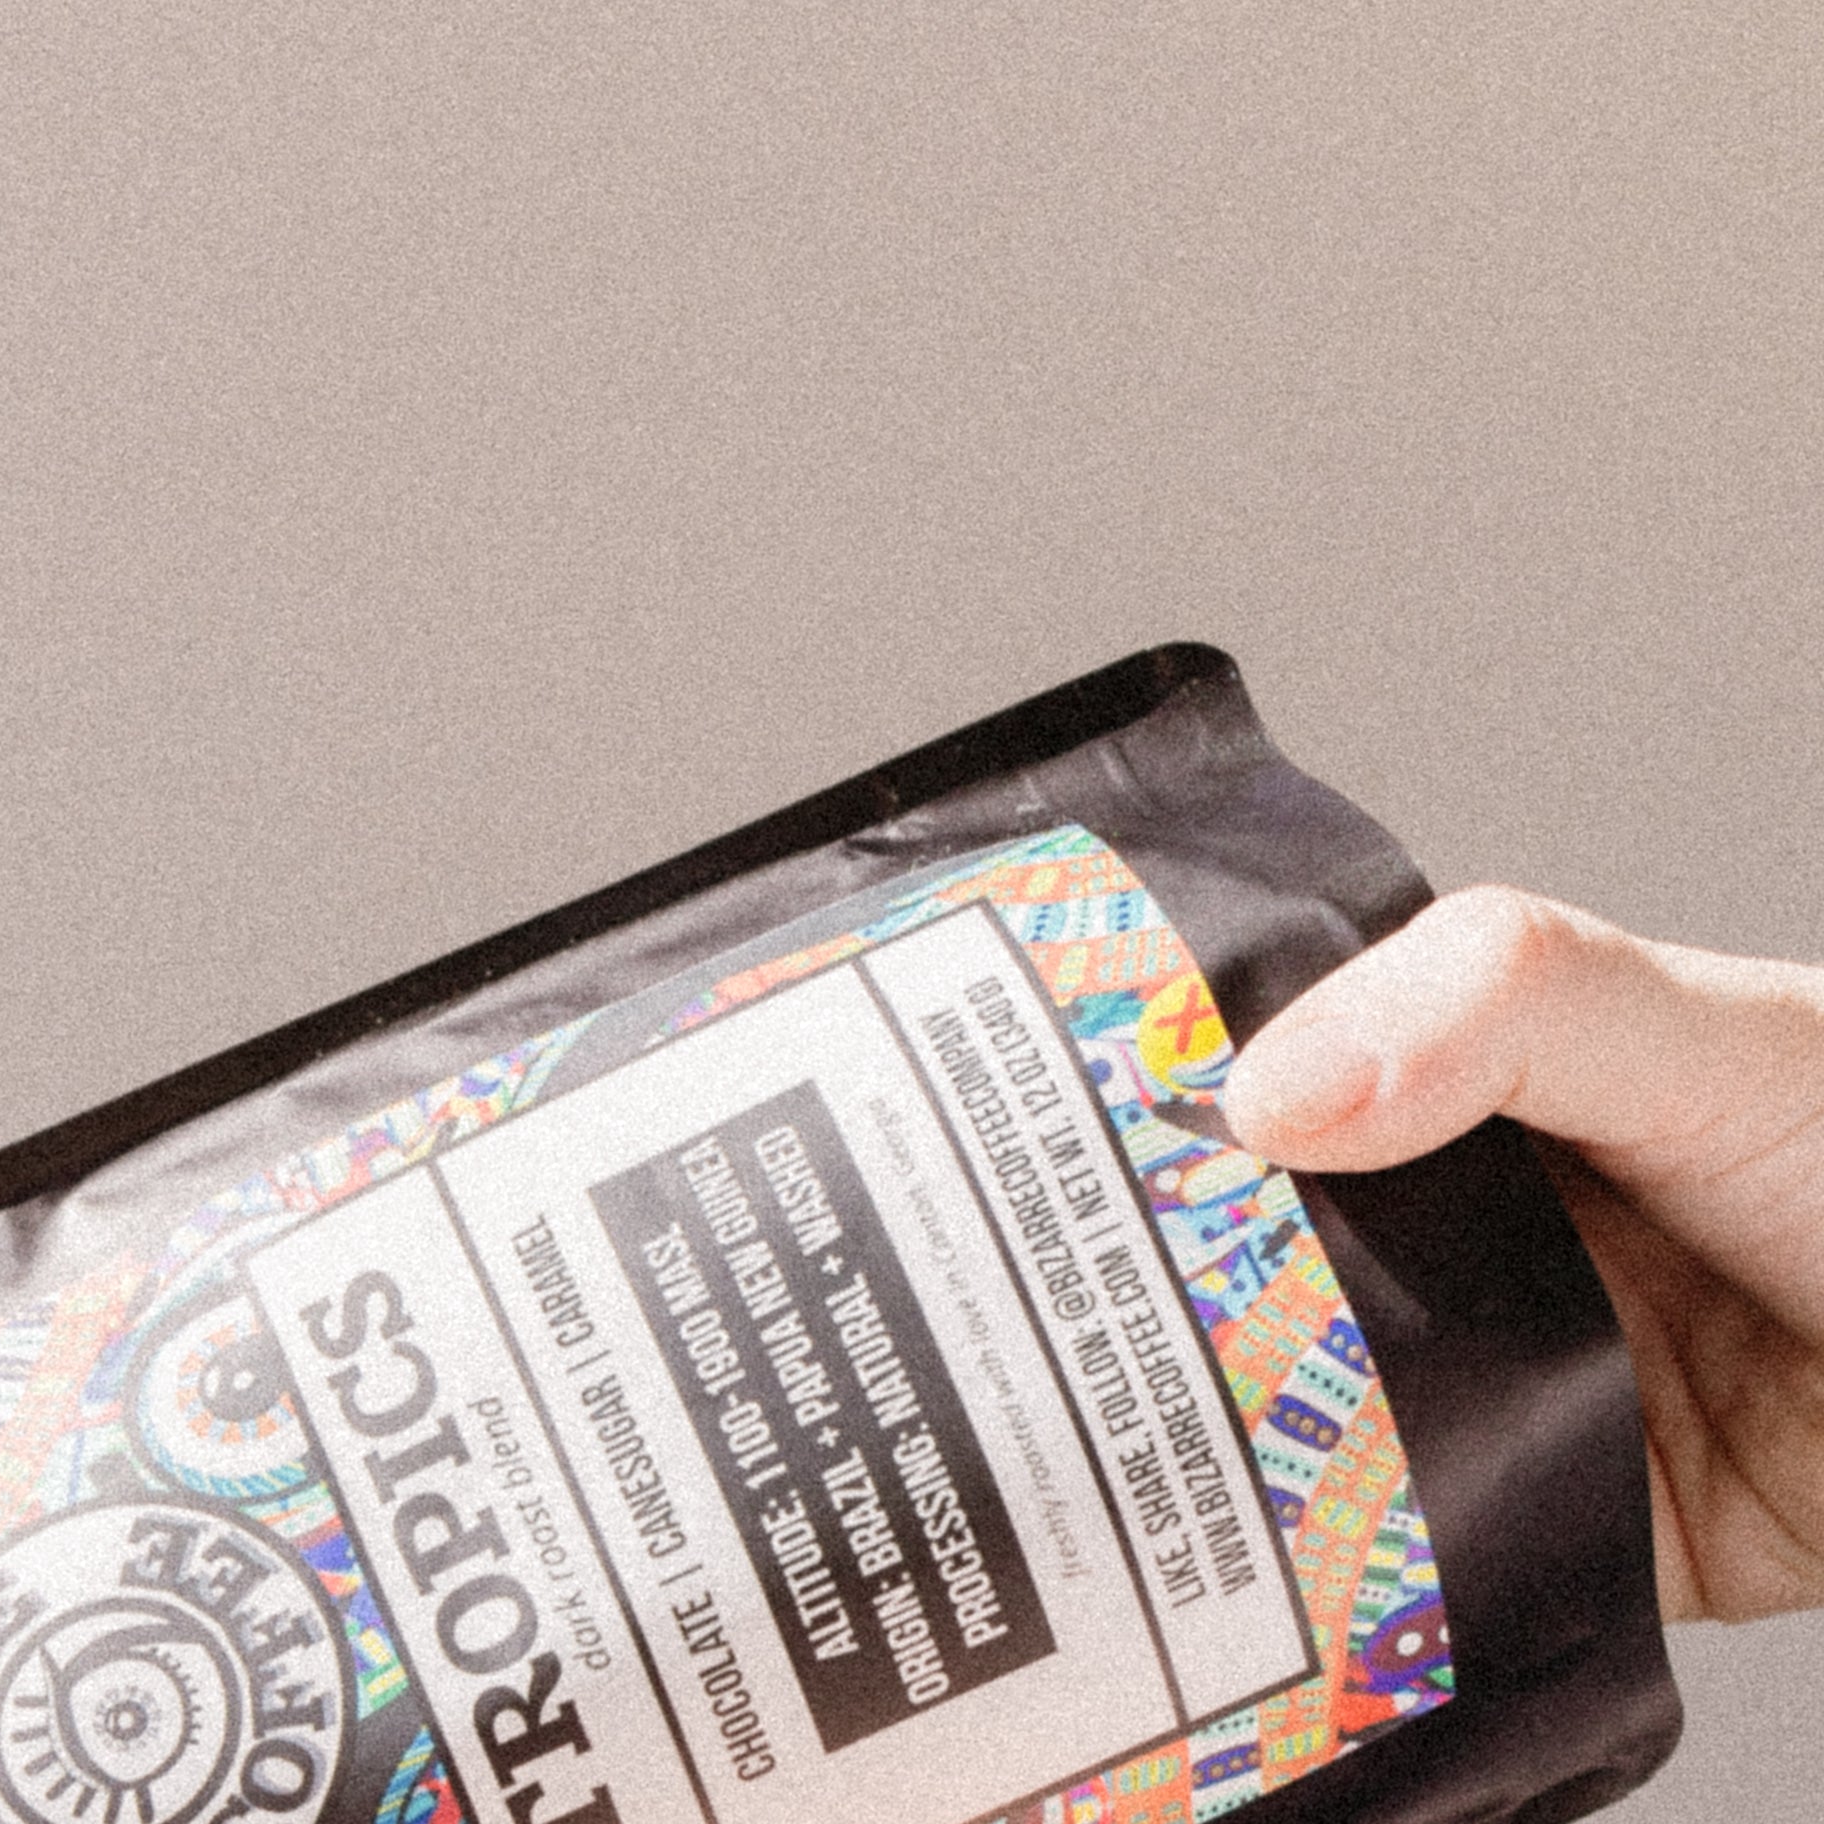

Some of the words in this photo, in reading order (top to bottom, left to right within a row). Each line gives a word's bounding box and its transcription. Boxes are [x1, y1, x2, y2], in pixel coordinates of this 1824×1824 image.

[1002, 1048, 1049, 1089] OZ
[1018, 1081, 1064, 1119] 12
[677, 1134, 761, 1249] GUINEA
[751, 1122, 847, 1256] WASHED
[918, 1004, 1099, 1325] @BIZARRECOFFEECOMPANY
[1035, 1116, 1088, 1171] WT.
[1057, 1164, 1111, 1222] NET
[505, 1213, 598, 1351] CARAMEL
[639, 1221, 713, 1318] MASL
[725, 1238, 795, 1321] NEW
[956, 1295, 993, 1346] love
[676, 1305, 790, 1493] 1100-1900
[756, 1308, 842, 1428] PAPUA
[819, 1271, 923, 1430] NATURAL
[975, 1346, 1016, 1403] with
[1069, 1318, 1147, 1439] FOLLOW:
[466, 1392, 536, 1495] blend
[579, 1372, 690, 1561] CANESUGAR
[997, 1401, 1055, 1496] roasted
[1092, 1243, 1258, 1597] WWW.BIZARRECOFFEE.COM
[816, 1445, 905, 1577] BRAZIL
[885, 1421, 1010, 1649] PROCESSING:
[1037, 1493, 1094, 1583] freshly
[1113, 1431, 1181, 1538] SHARE,
[512, 1495, 575, 1588] roast
[754, 1488, 861, 1666] ALTITUDE:
[1151, 1532, 1208, 1611] LIKE,
[550, 1588, 614, 1678] dark
[671, 1590, 780, 1787] CHOCOLATE
[867, 1570, 953, 1707] ORIGIN:
